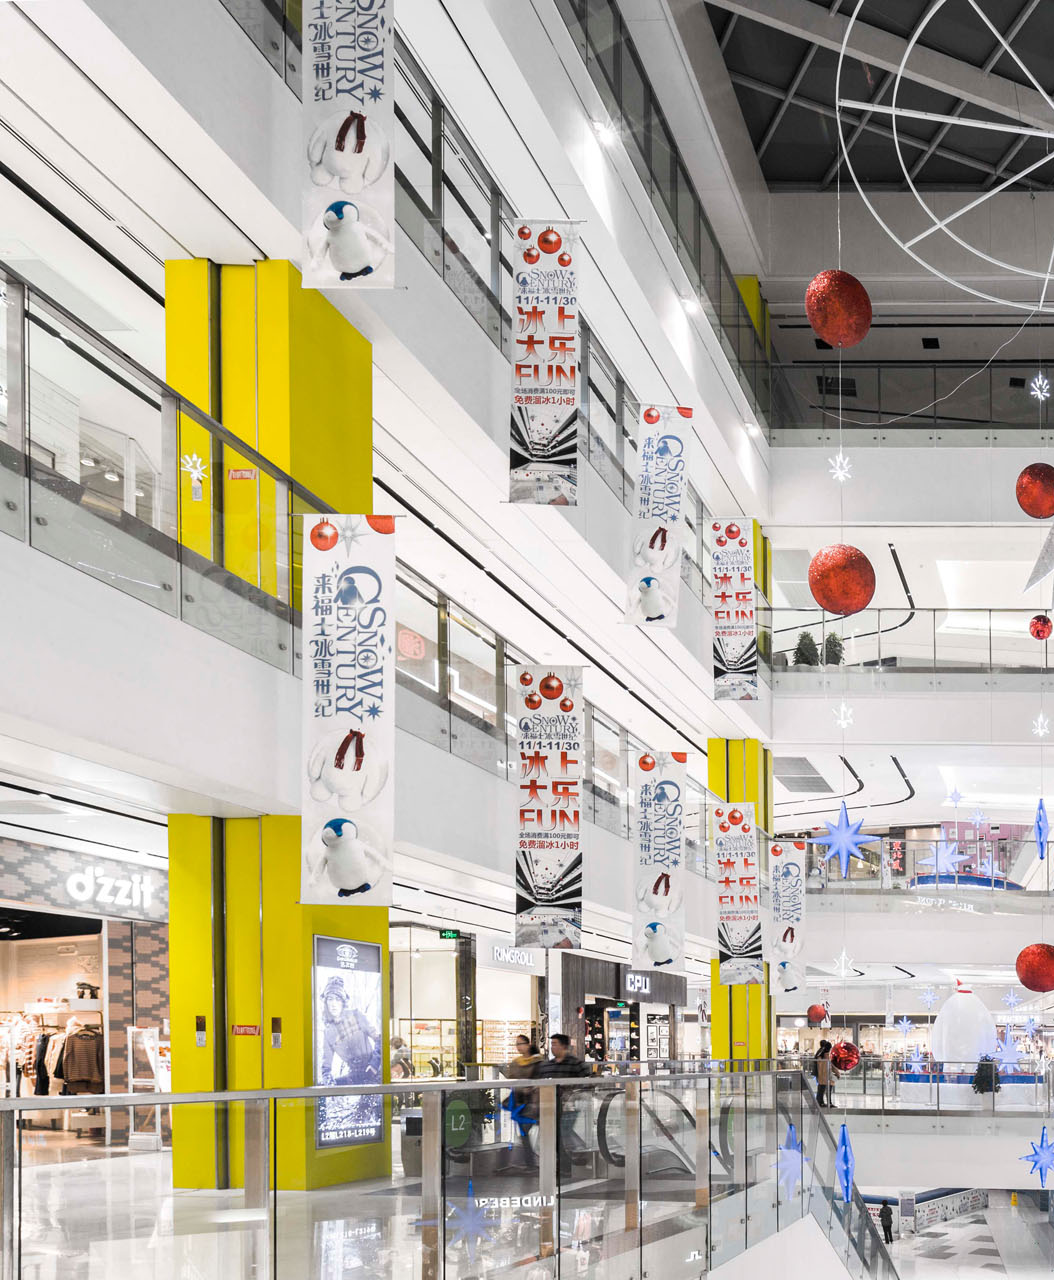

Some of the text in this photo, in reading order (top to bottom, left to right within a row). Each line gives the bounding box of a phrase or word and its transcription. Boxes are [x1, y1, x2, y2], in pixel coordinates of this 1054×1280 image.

[335, 0, 365, 106] NTURY
[516, 271, 577, 288] CENTURY
[530, 268, 568, 280] SNOW
[515, 296, 577, 306] 11/1-11/30
[516, 306, 577, 334] 冰上
[516, 335, 576, 364] 大乐
[515, 364, 576, 387] FUN
[514, 395, 575, 406] 免费溜冰1小时
[652, 435, 684, 524] CENTURY
[664, 460, 685, 512] SNOW
[713, 573, 752, 591] 冰上
[714, 591, 752, 609] 大乐
[714, 610, 753, 624] FUN
[309, 573, 335, 718] 来福士冰雪世纪
[334, 566, 382, 723] CENTURY
[357, 606, 387, 702] SNOW
[519, 717, 579, 734] CENTURY
[532, 714, 570, 725] SNOW
[518, 741, 580, 750] 11/1-11/30
[520, 751, 580, 779] 冰上
[520, 780, 580, 808] 大乐
[520, 809, 580, 832] FUN
[653, 780, 681, 869] CENTURY
[665, 803, 683, 857] SNOW
[519, 840, 579, 850] 免费溜冰1小时
[717, 858, 756, 876] 冰上
[718, 876, 757, 894] 大乐
[719, 895, 758, 909] FUN
[493, 946, 534, 967] RINGROLL
[451, 1114, 465, 1131] L2
